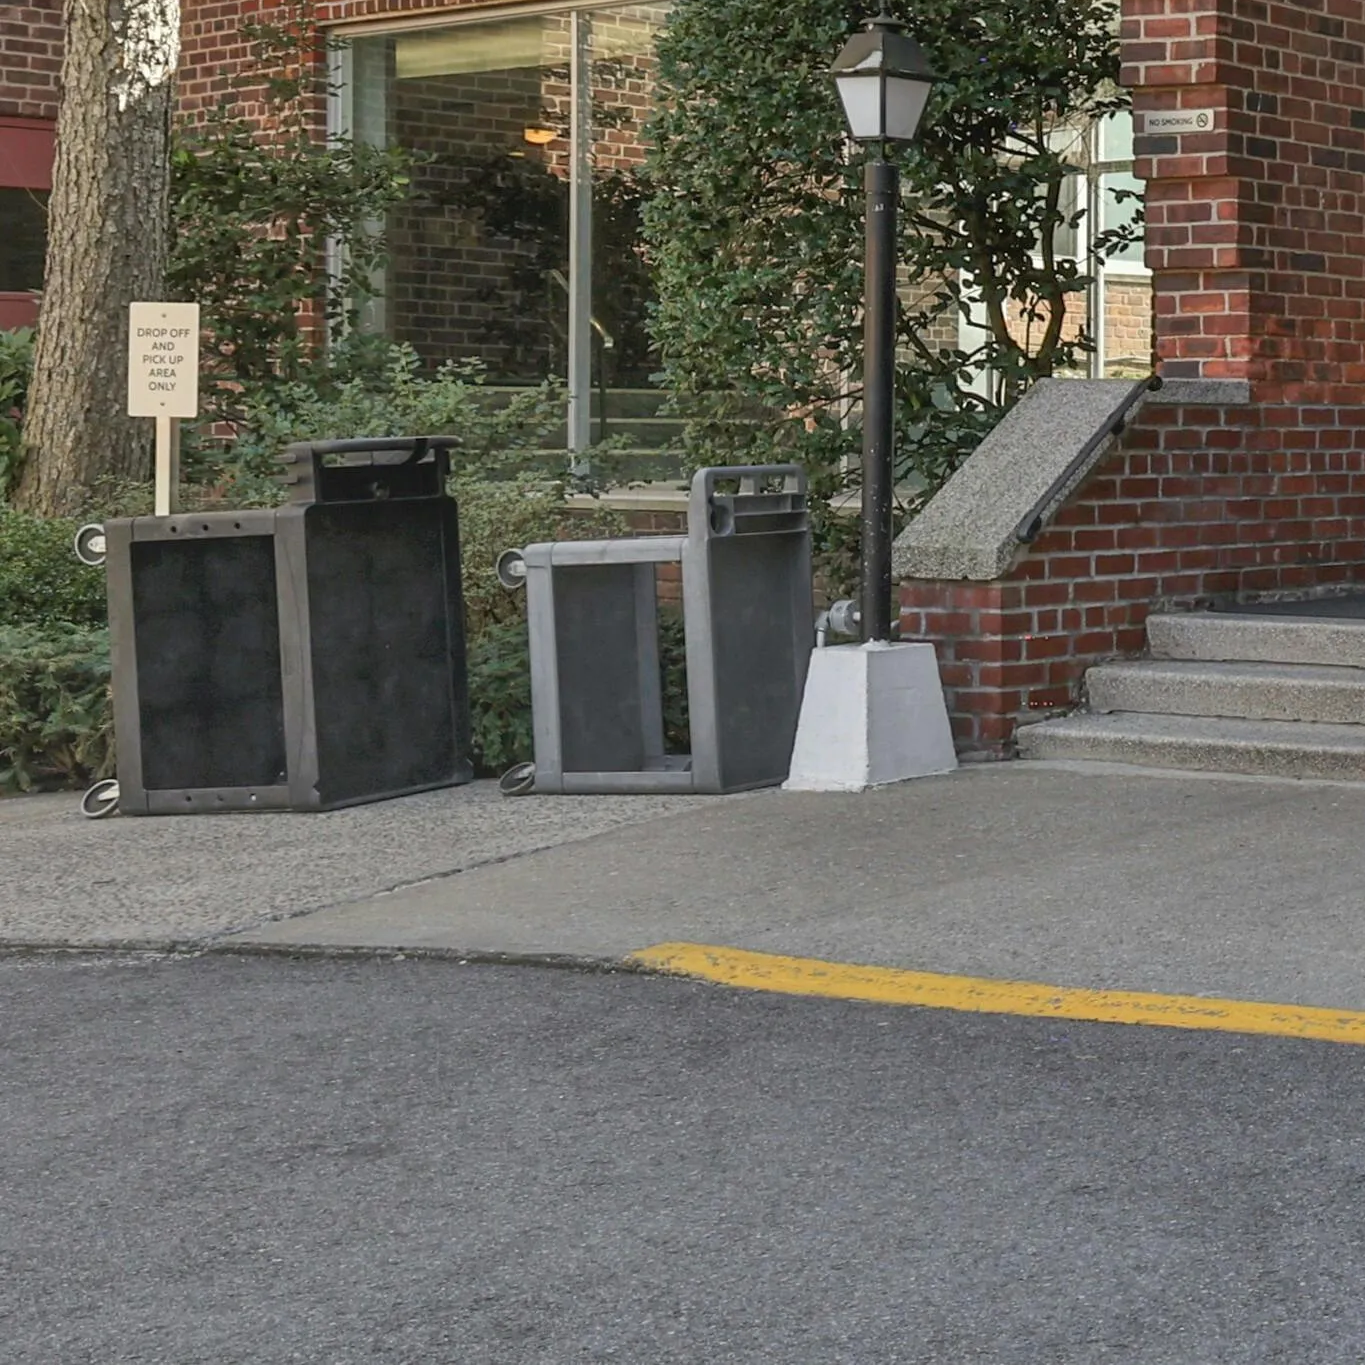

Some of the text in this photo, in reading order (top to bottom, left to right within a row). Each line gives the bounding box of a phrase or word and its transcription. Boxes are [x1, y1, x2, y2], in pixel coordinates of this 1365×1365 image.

[1149, 117, 1193, 127] NO SMOKING
[137, 327, 191, 338] DROP OFF
[151, 341, 175, 351] AND
[142, 354, 184, 365] PICK UP
[148, 368, 177, 378] AREA
[148, 381, 177, 392] ONLY
